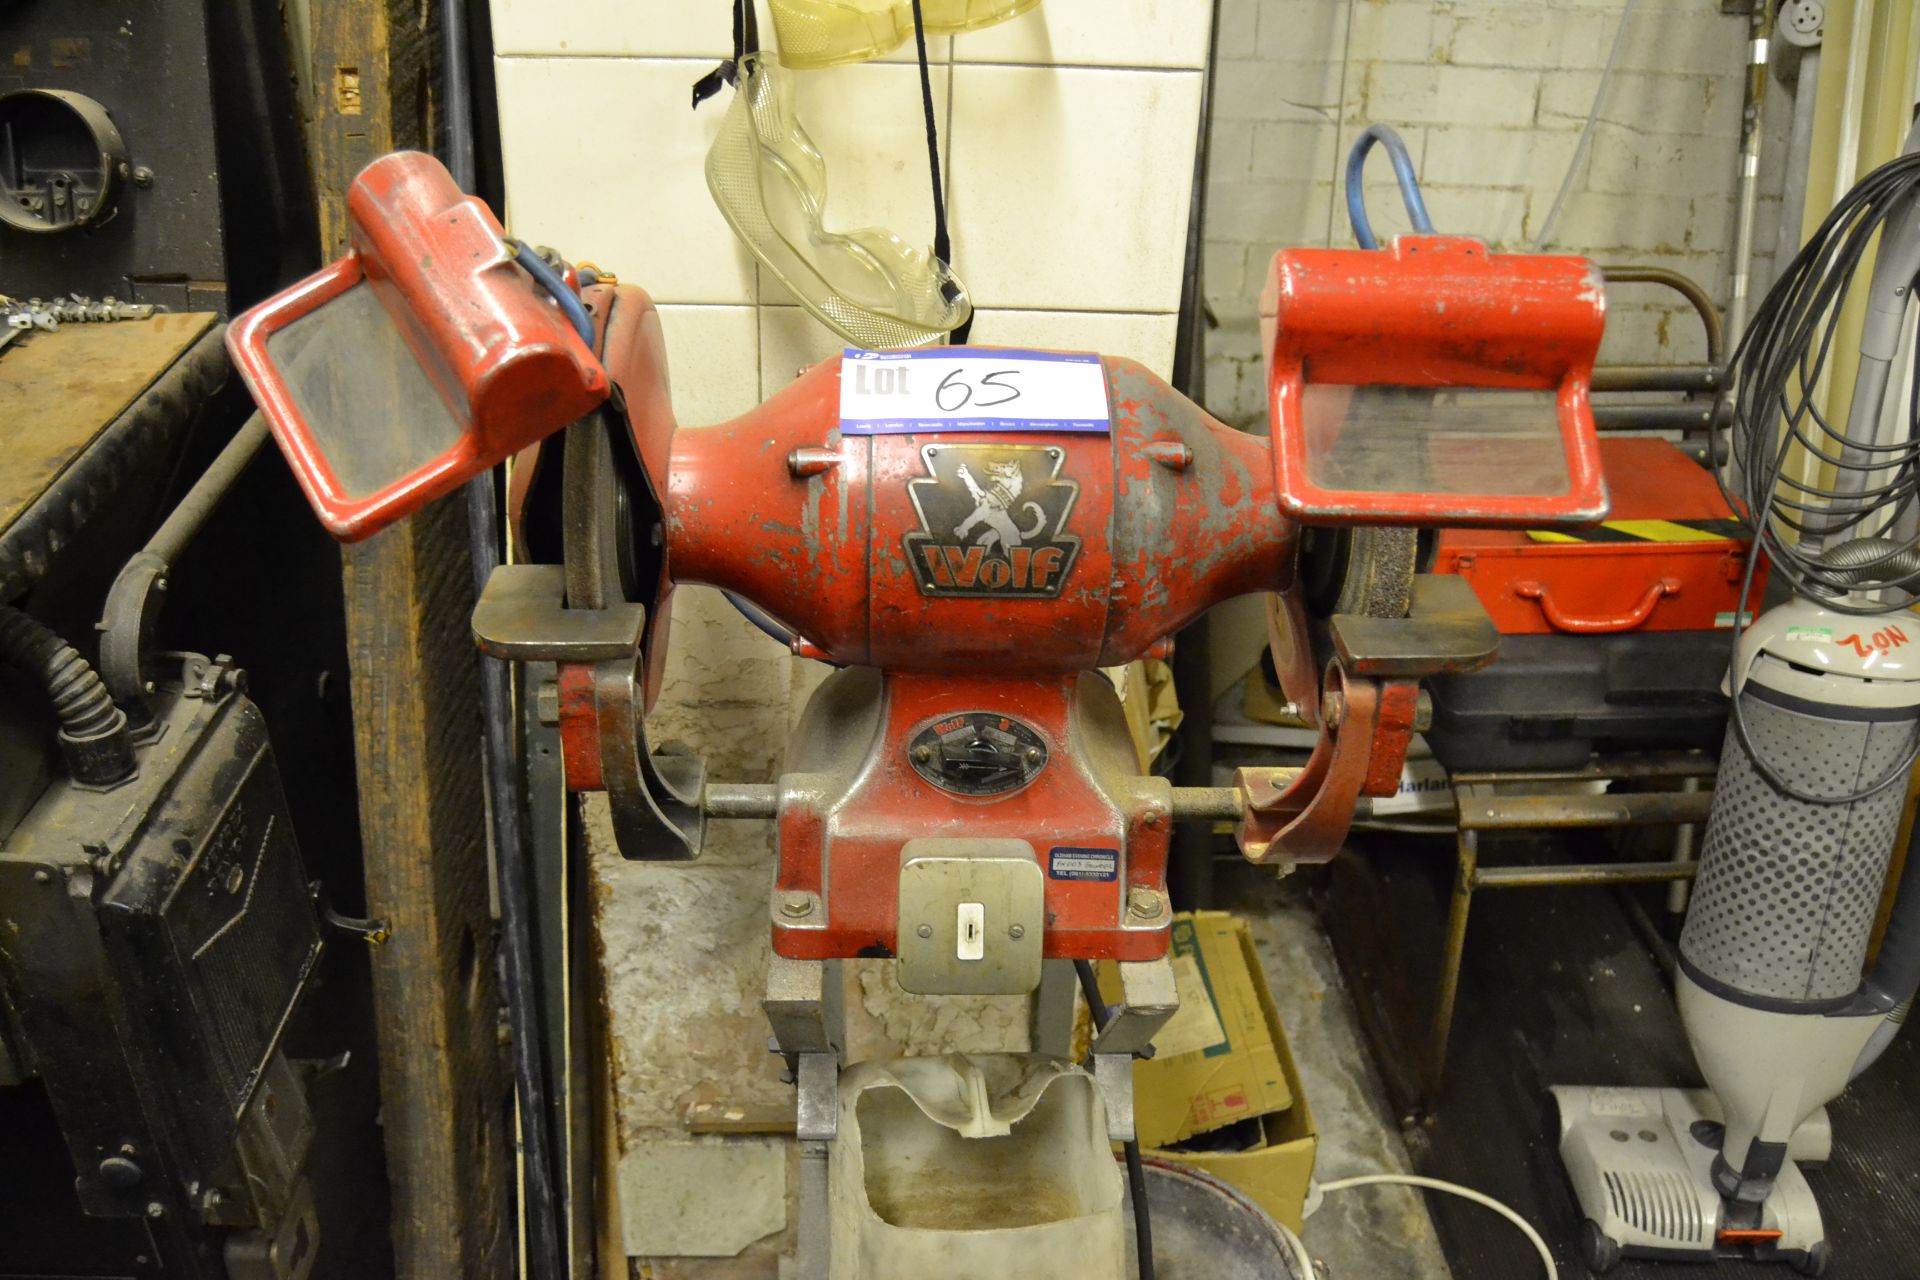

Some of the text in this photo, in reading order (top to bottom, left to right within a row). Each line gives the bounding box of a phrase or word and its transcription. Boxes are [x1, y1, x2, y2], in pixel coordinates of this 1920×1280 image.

[856, 364, 910, 395] Lot
[935, 368, 1021, 412] 65
[921, 545, 1065, 589] Wolf
